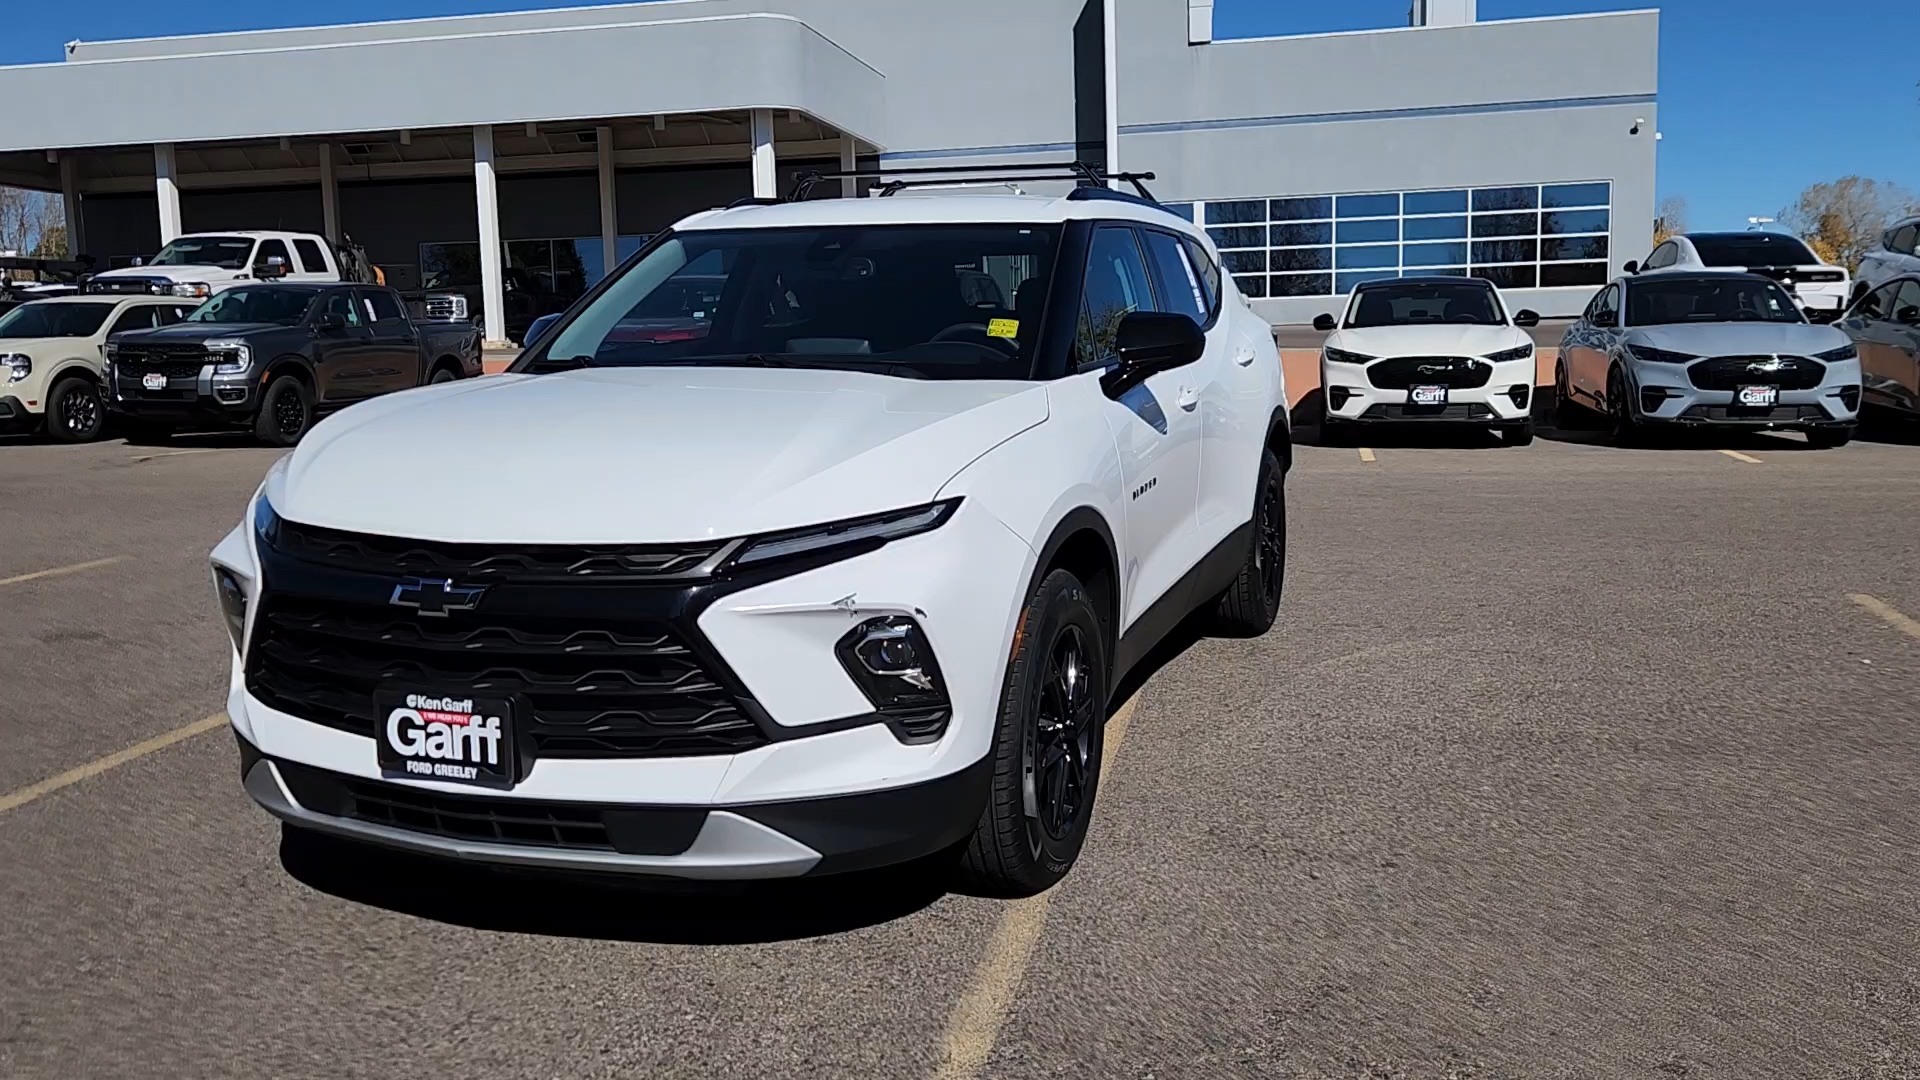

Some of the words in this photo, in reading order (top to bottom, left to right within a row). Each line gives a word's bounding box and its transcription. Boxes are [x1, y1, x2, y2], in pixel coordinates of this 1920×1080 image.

[1411, 388, 1446, 401] Garff
[1739, 389, 1777, 402] Garff
[387, 708, 501, 765] Garff
[406, 760, 432, 775] FORD
[434, 763, 478, 780] GREELEY
